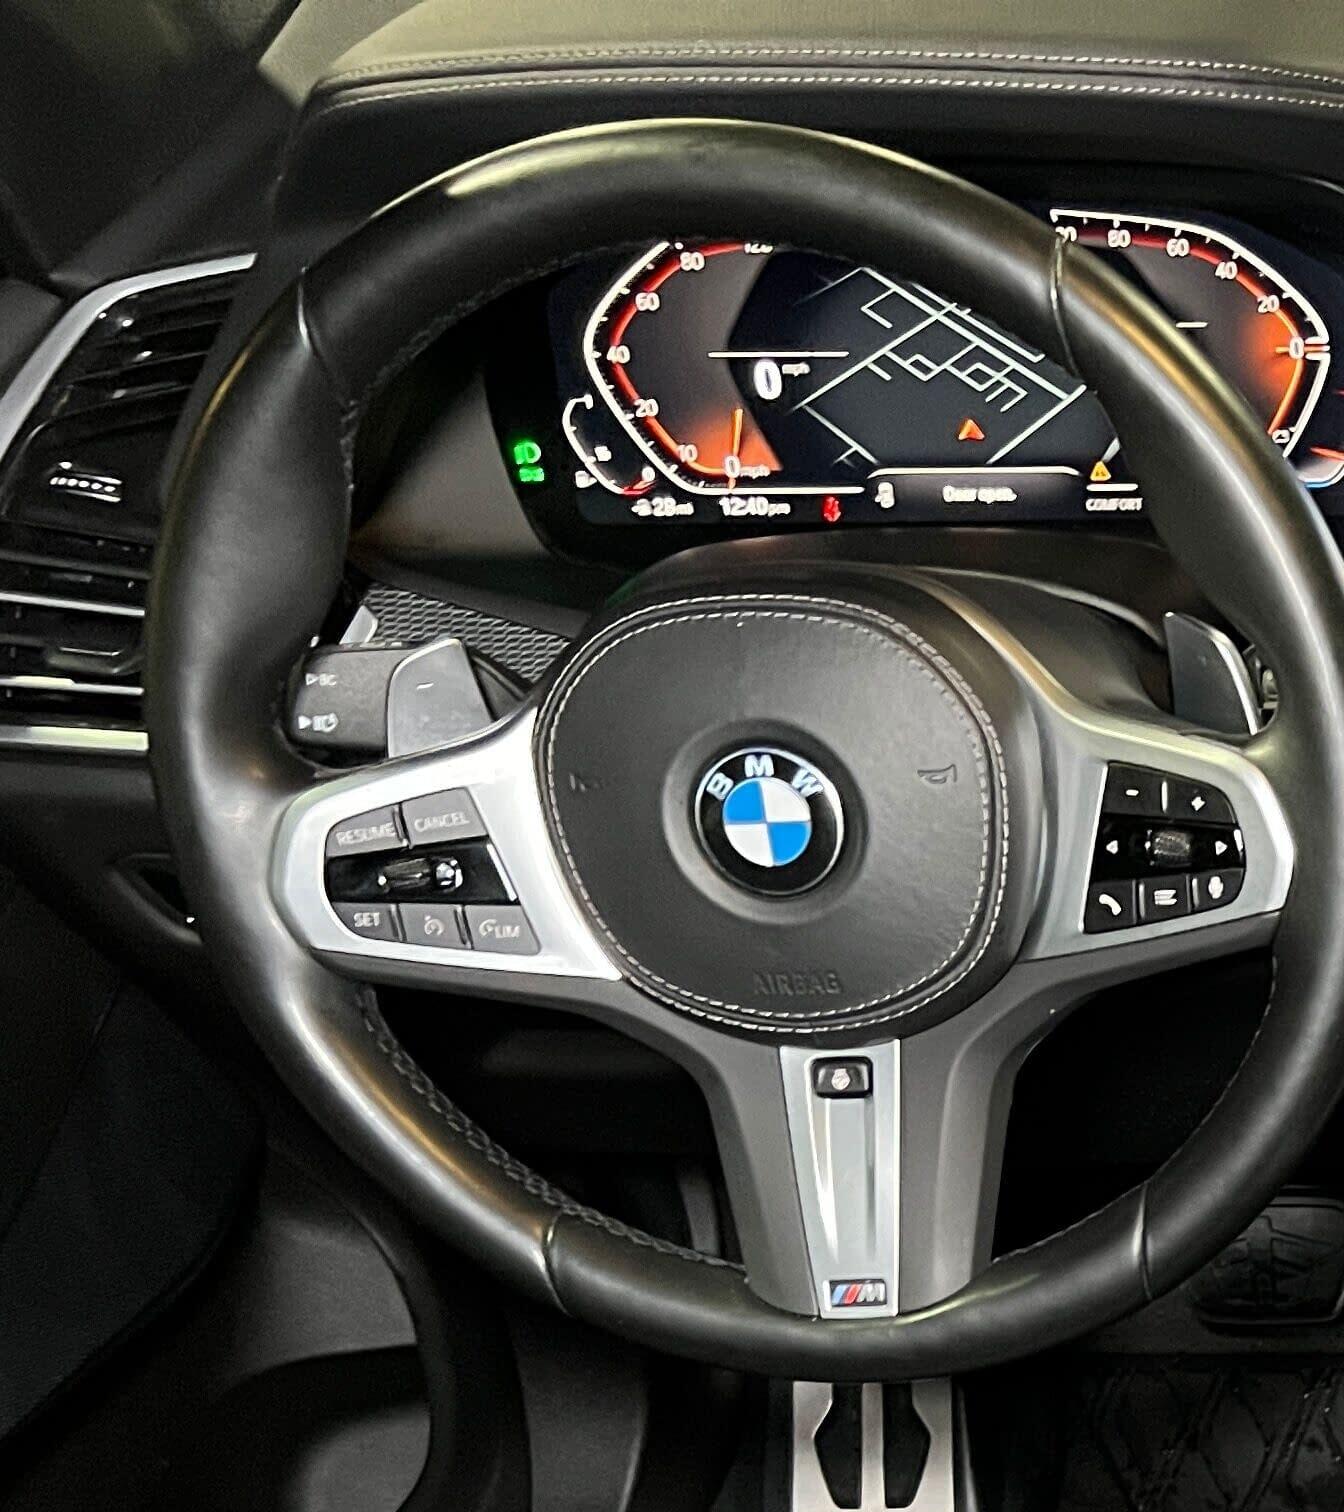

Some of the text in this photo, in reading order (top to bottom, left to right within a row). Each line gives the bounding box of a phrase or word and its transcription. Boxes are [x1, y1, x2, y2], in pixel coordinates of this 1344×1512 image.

[1107, 229, 1131, 249] 80
[1166, 239, 1190, 258] 60
[1214, 261, 1239, 280] 40
[1257, 293, 1281, 313] 20
[606, 344, 631, 364] 40
[1289, 337, 1304, 360] 0
[753, 359, 783, 401] 0
[634, 398, 660, 418] 20
[705, 753, 825, 801] BMW
[413, 810, 469, 832] CANCEL
[335, 820, 397, 847] RESUME
[353, 910, 381, 928] SET
[752, 971, 841, 998] AIRBAG
